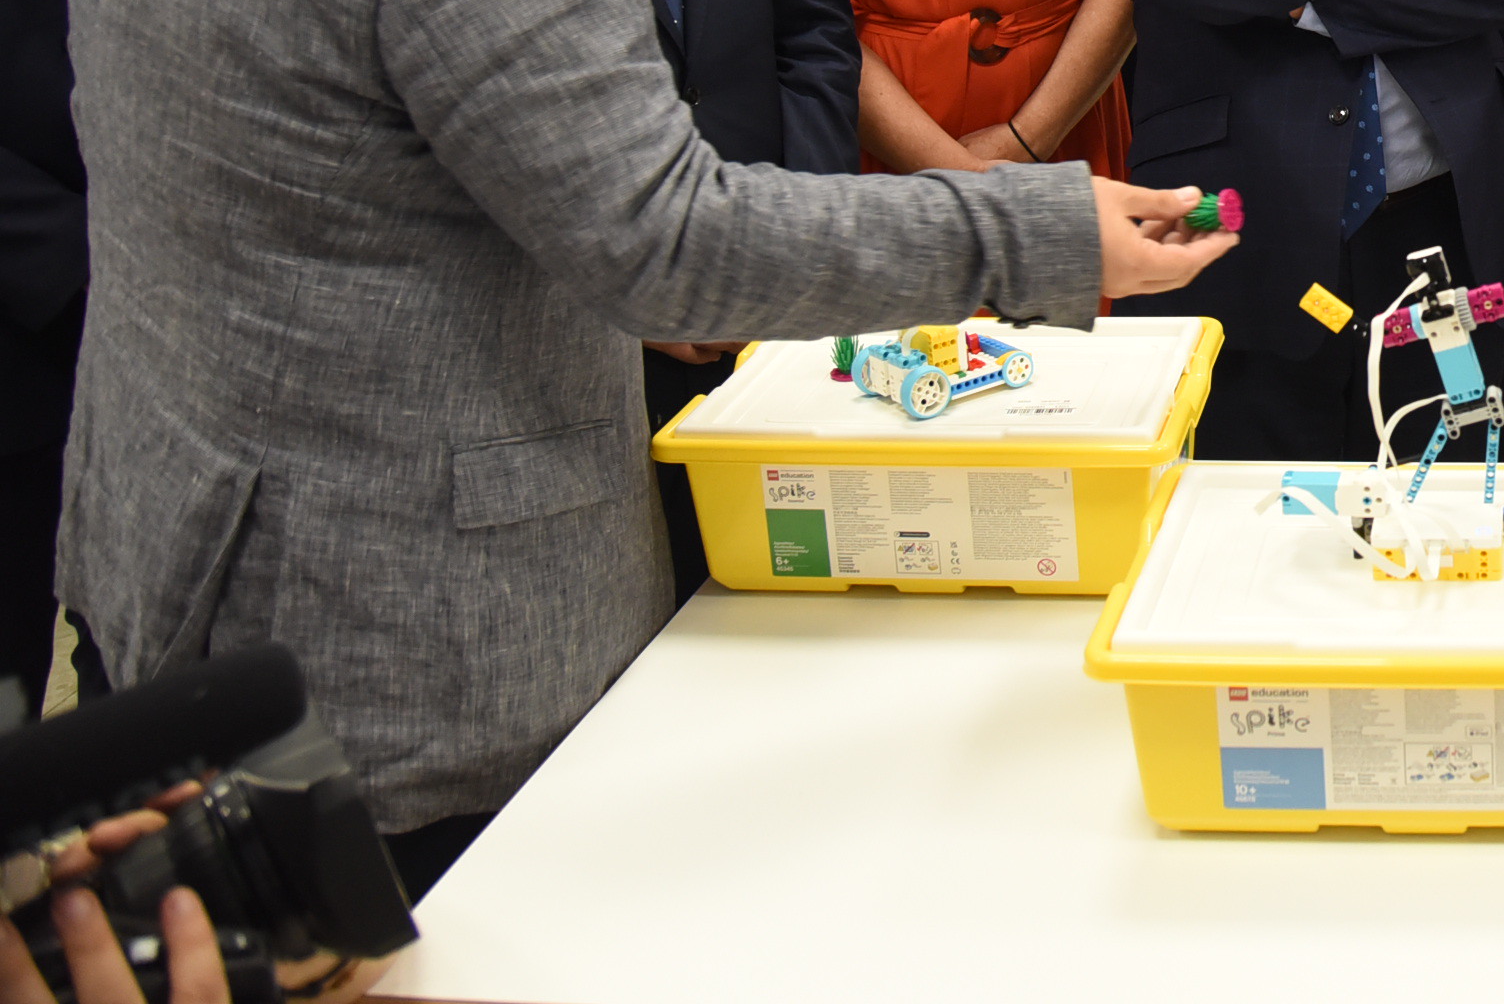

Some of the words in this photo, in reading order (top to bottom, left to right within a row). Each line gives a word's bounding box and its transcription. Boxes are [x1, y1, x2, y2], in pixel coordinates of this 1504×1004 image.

[775, 556, 790, 566] 6+
[1251, 687, 1309, 697] education
[1230, 704, 1311, 736] spike
[1235, 784, 1257, 796] 10+
